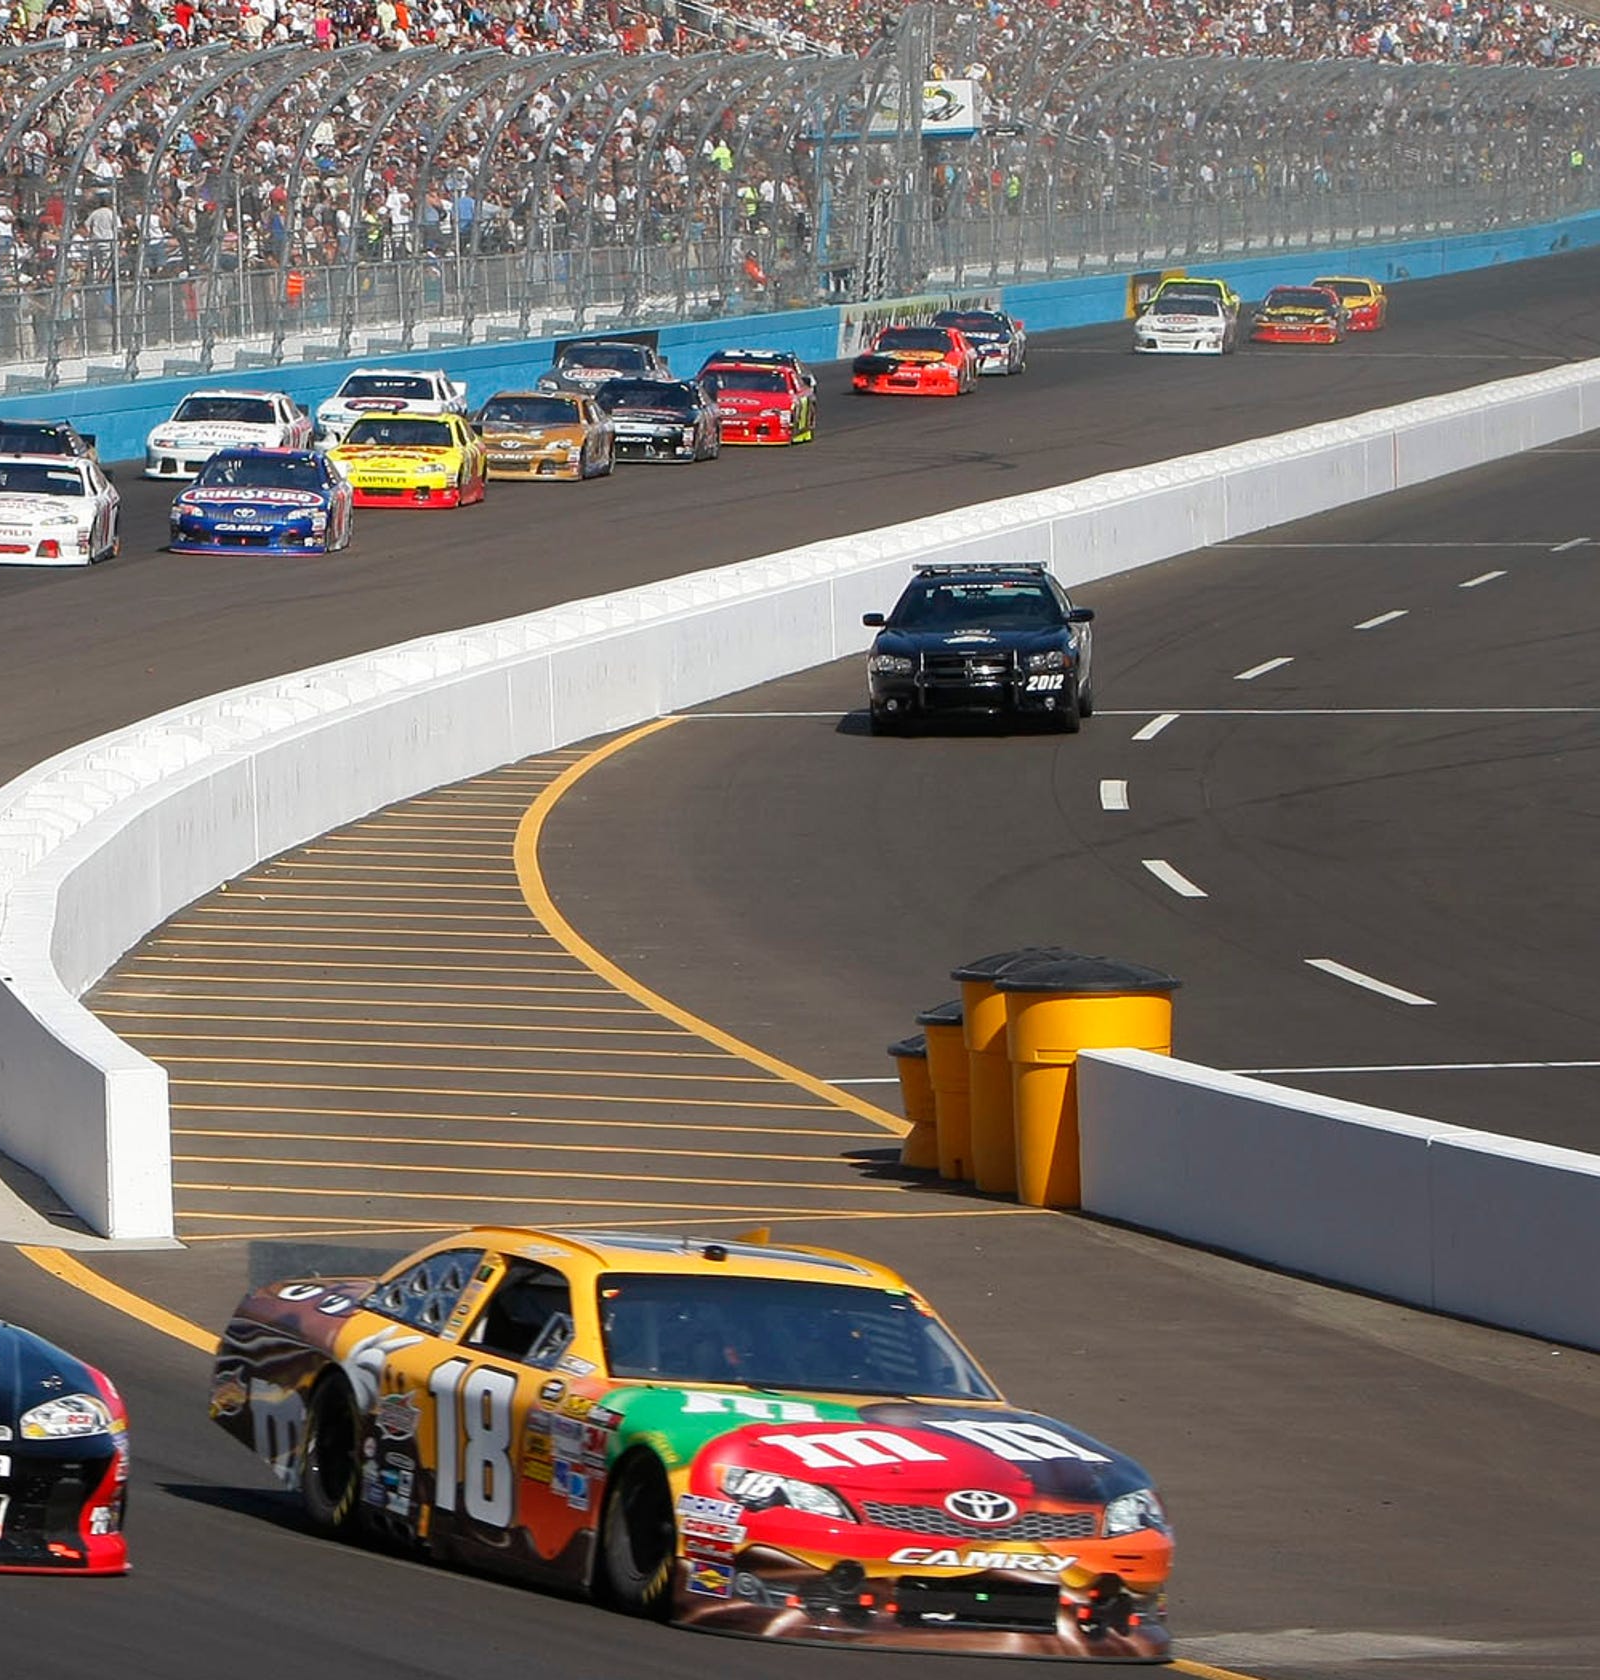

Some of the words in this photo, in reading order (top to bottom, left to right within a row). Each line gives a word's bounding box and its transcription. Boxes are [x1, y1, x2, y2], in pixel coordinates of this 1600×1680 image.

[195, 488, 312, 502] KINGSFORD
[214, 523, 274, 533] CAMRY
[1025, 674, 1065, 692] 2012
[429, 1357, 518, 1528] 18
[759, 1430, 947, 1467] m
[735, 1471, 780, 1499] 18
[888, 1547, 1080, 1572] CAMRY
